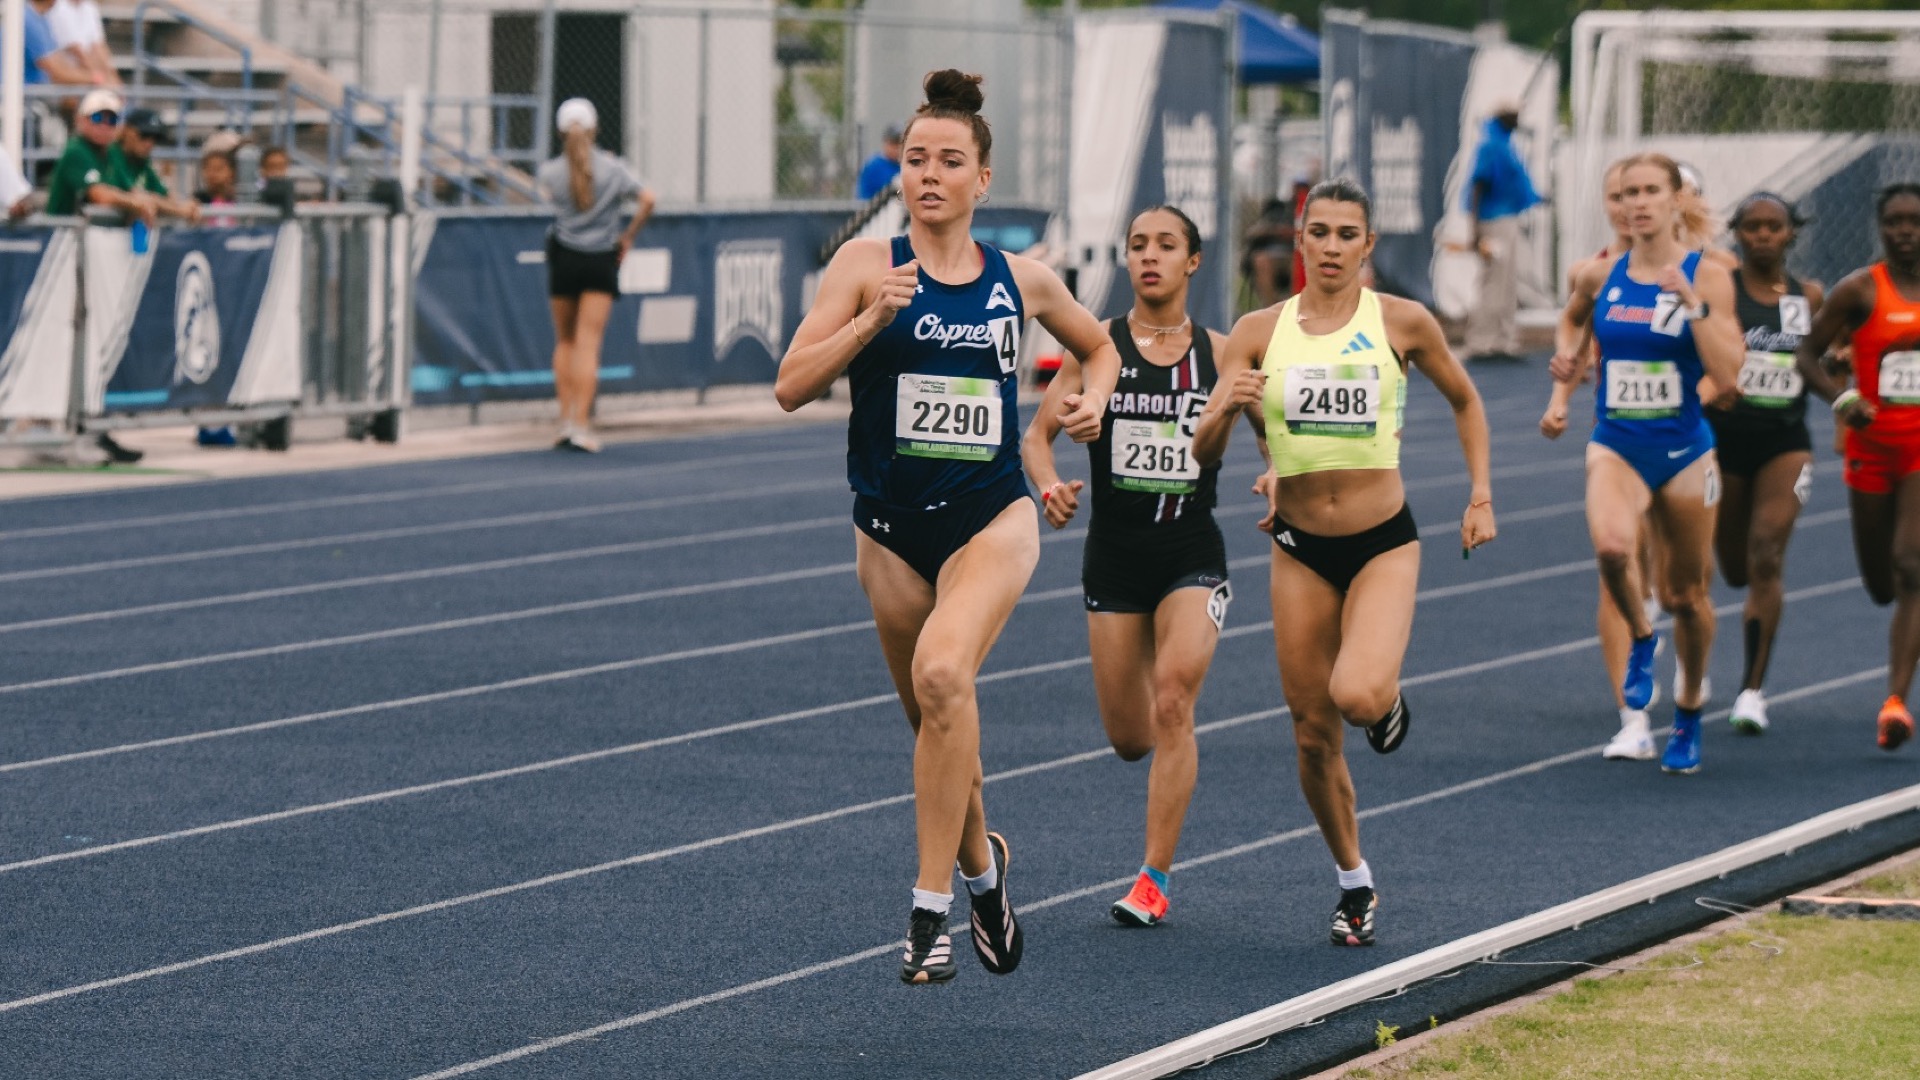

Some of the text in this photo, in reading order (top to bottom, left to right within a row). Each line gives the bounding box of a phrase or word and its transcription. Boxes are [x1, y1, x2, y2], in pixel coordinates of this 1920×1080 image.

[1664, 300, 1681, 328] 7
[1785, 302, 1801, 328] 2
[1000, 320, 1015, 368] 4
[1617, 381, 1669, 402] 2114
[1892, 370, 1920, 391] 21
[1299, 388, 1367, 415] 2498
[912, 401, 989, 437] 2290
[1182, 397, 1208, 437] 5
[1125, 443, 1188, 473] 2361
